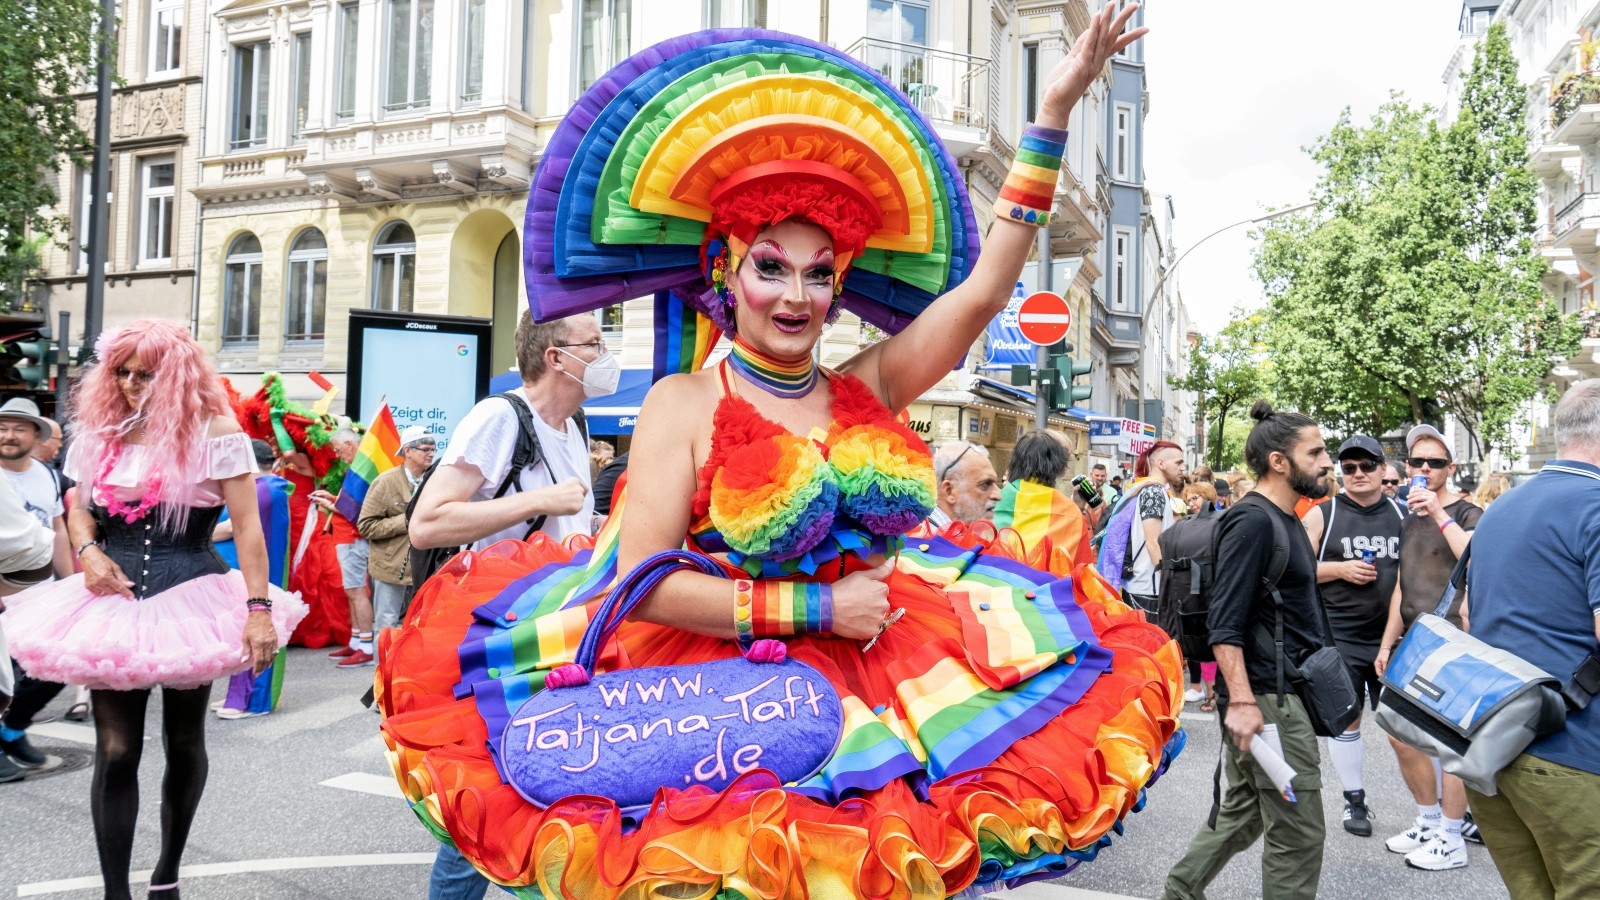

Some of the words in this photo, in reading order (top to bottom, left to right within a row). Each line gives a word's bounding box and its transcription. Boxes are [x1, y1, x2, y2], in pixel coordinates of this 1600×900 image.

[405, 322, 438, 330] JCDecaux
[993, 339, 1032, 351] Wirtshaus
[390, 406, 424, 421] Zeigt
[427, 407, 447, 421] dir,
[1121, 419, 1141, 434] FREE
[598, 672, 715, 708] www.
[511, 674, 825, 773] Tatjana-Taft
[684, 727, 763, 784] .de
